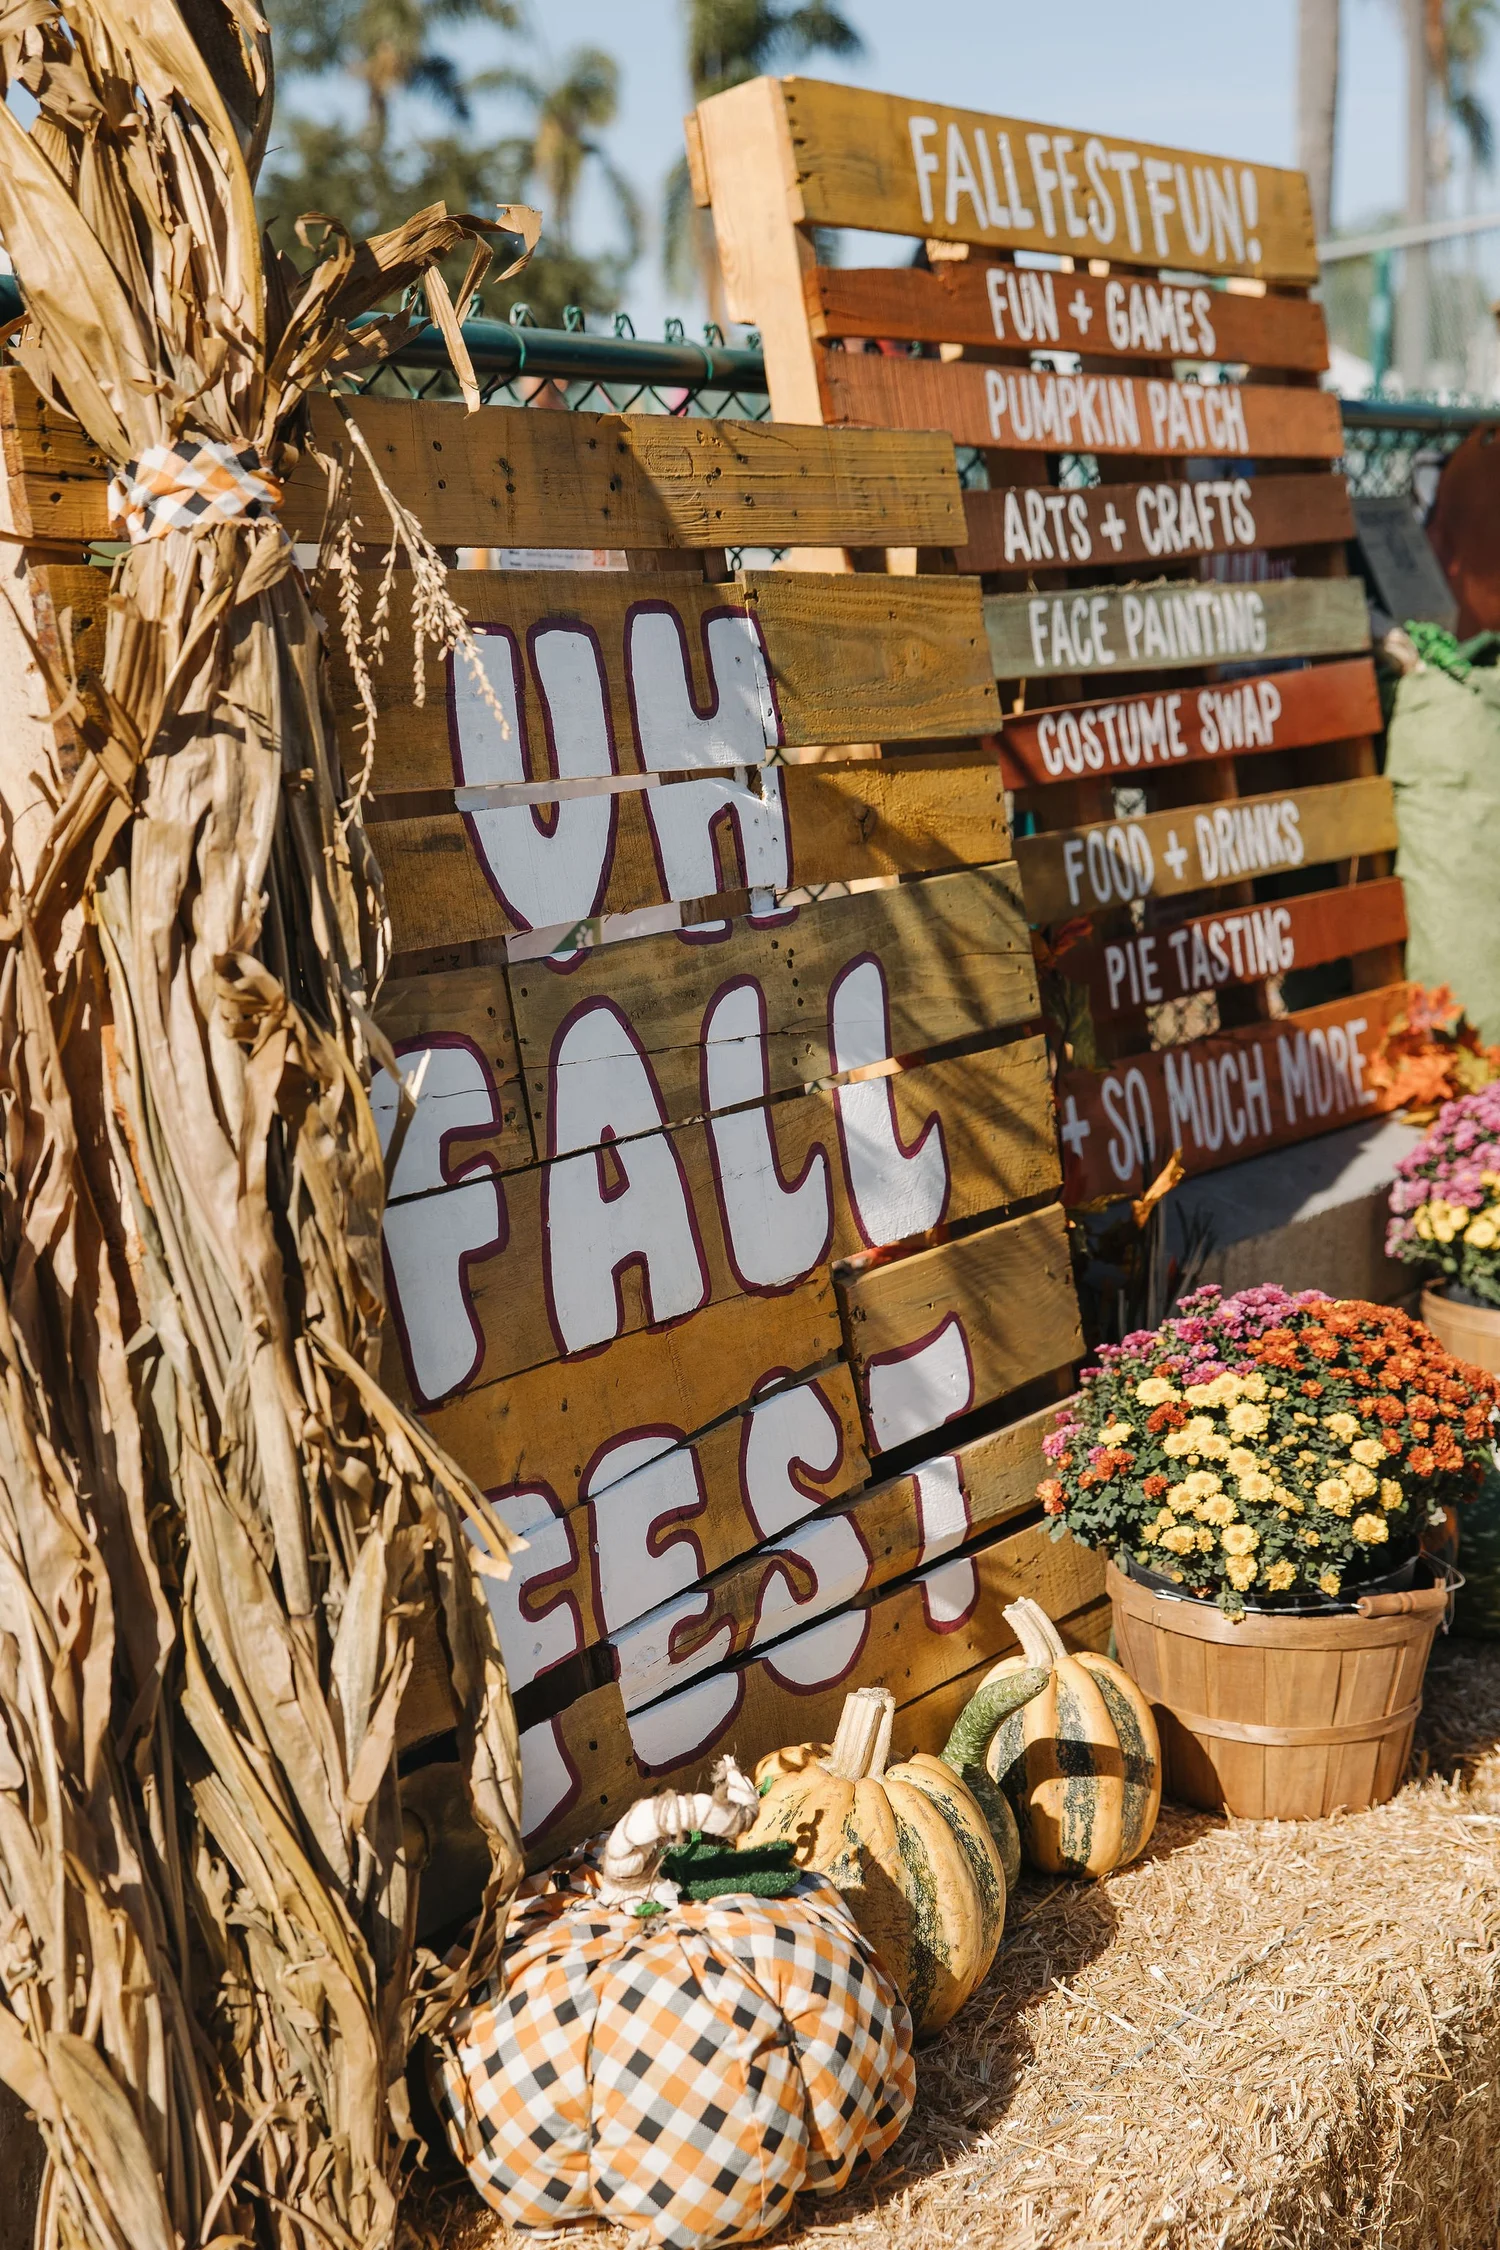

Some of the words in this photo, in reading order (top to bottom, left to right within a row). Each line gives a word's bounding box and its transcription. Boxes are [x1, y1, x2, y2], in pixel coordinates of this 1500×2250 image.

[986, 268, 1059, 342] FUN
[1105, 280, 1216, 357] GAMES
[985, 369, 1140, 448] PUMPKIN
[1147, 380, 1249, 454] PATCH
[1004, 488, 1092, 564] ARTS
[1136, 477, 1256, 557] CRAFTS
[1028, 597, 1116, 668] FACE
[1123, 590, 1267, 661] PAINTING
[1036, 693, 1188, 776] COSTUME
[1197, 680, 1282, 754] SWAP
[1063, 822, 1155, 906] FOOD
[1194, 799, 1305, 882] DRINKS
[1104, 935, 1163, 1010] PIE
[1167, 907, 1295, 991] TASTING
[1101, 1067, 1156, 1182] SO
[1163, 1042, 1272, 1151] MUCH
[1277, 1018, 1377, 1125] MORE
[368, 950, 953, 1414] FALL
[462, 1312, 978, 1843] FEST
